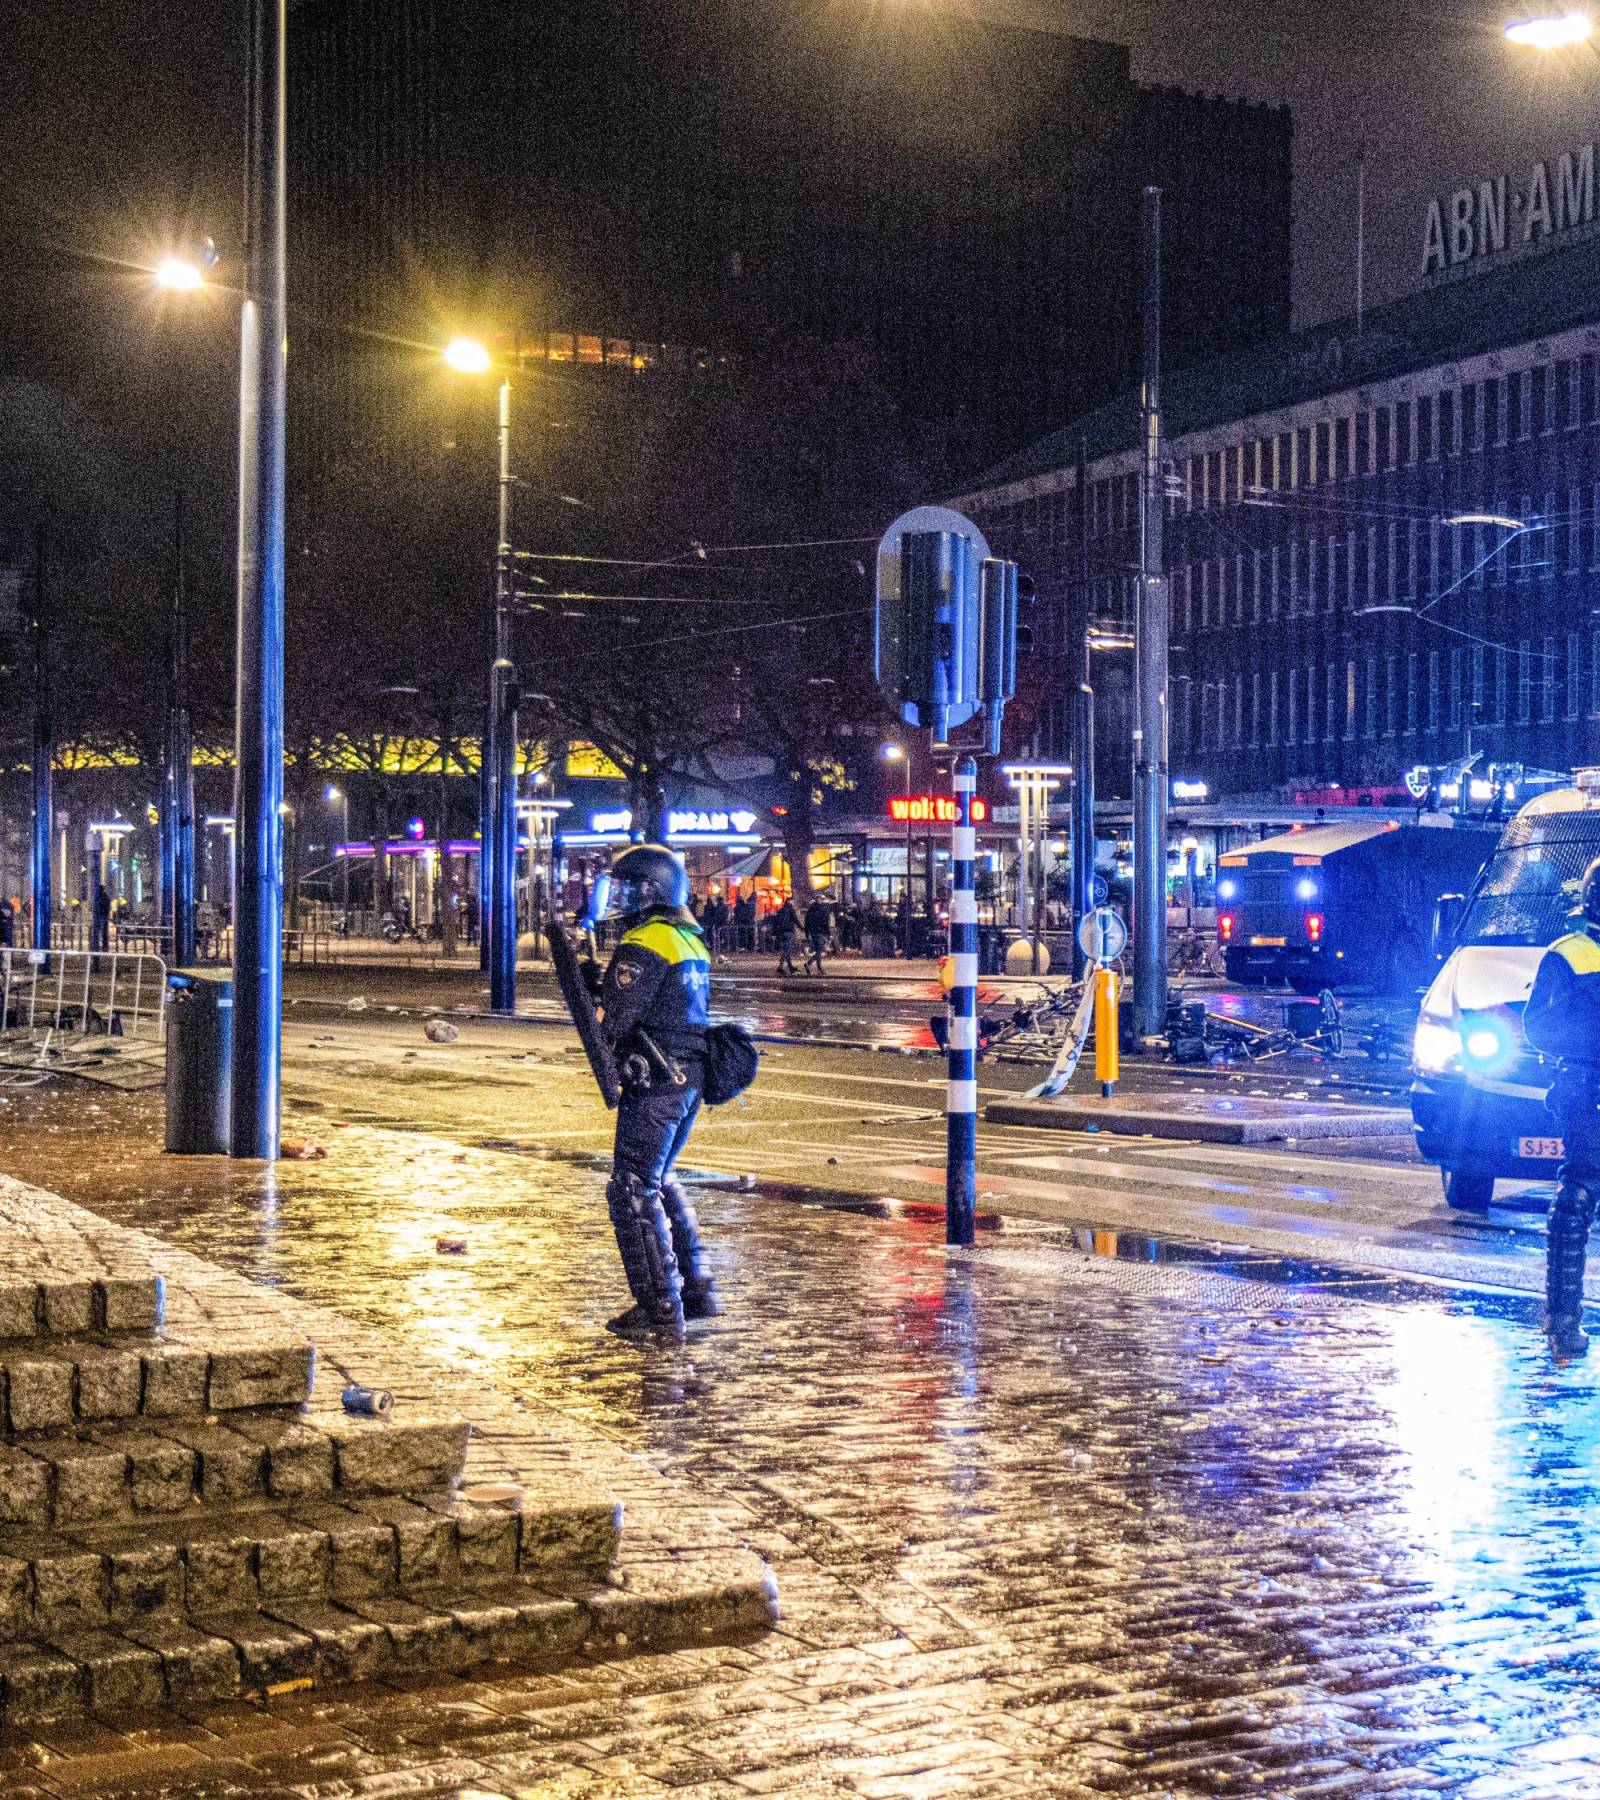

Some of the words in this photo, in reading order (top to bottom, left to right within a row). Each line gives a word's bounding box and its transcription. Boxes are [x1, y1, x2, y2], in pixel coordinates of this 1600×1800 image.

[1421, 176, 1506, 275] ABN
[891, 797, 935, 820] wok
[1525, 1140, 1563, 1156] SJ-3
